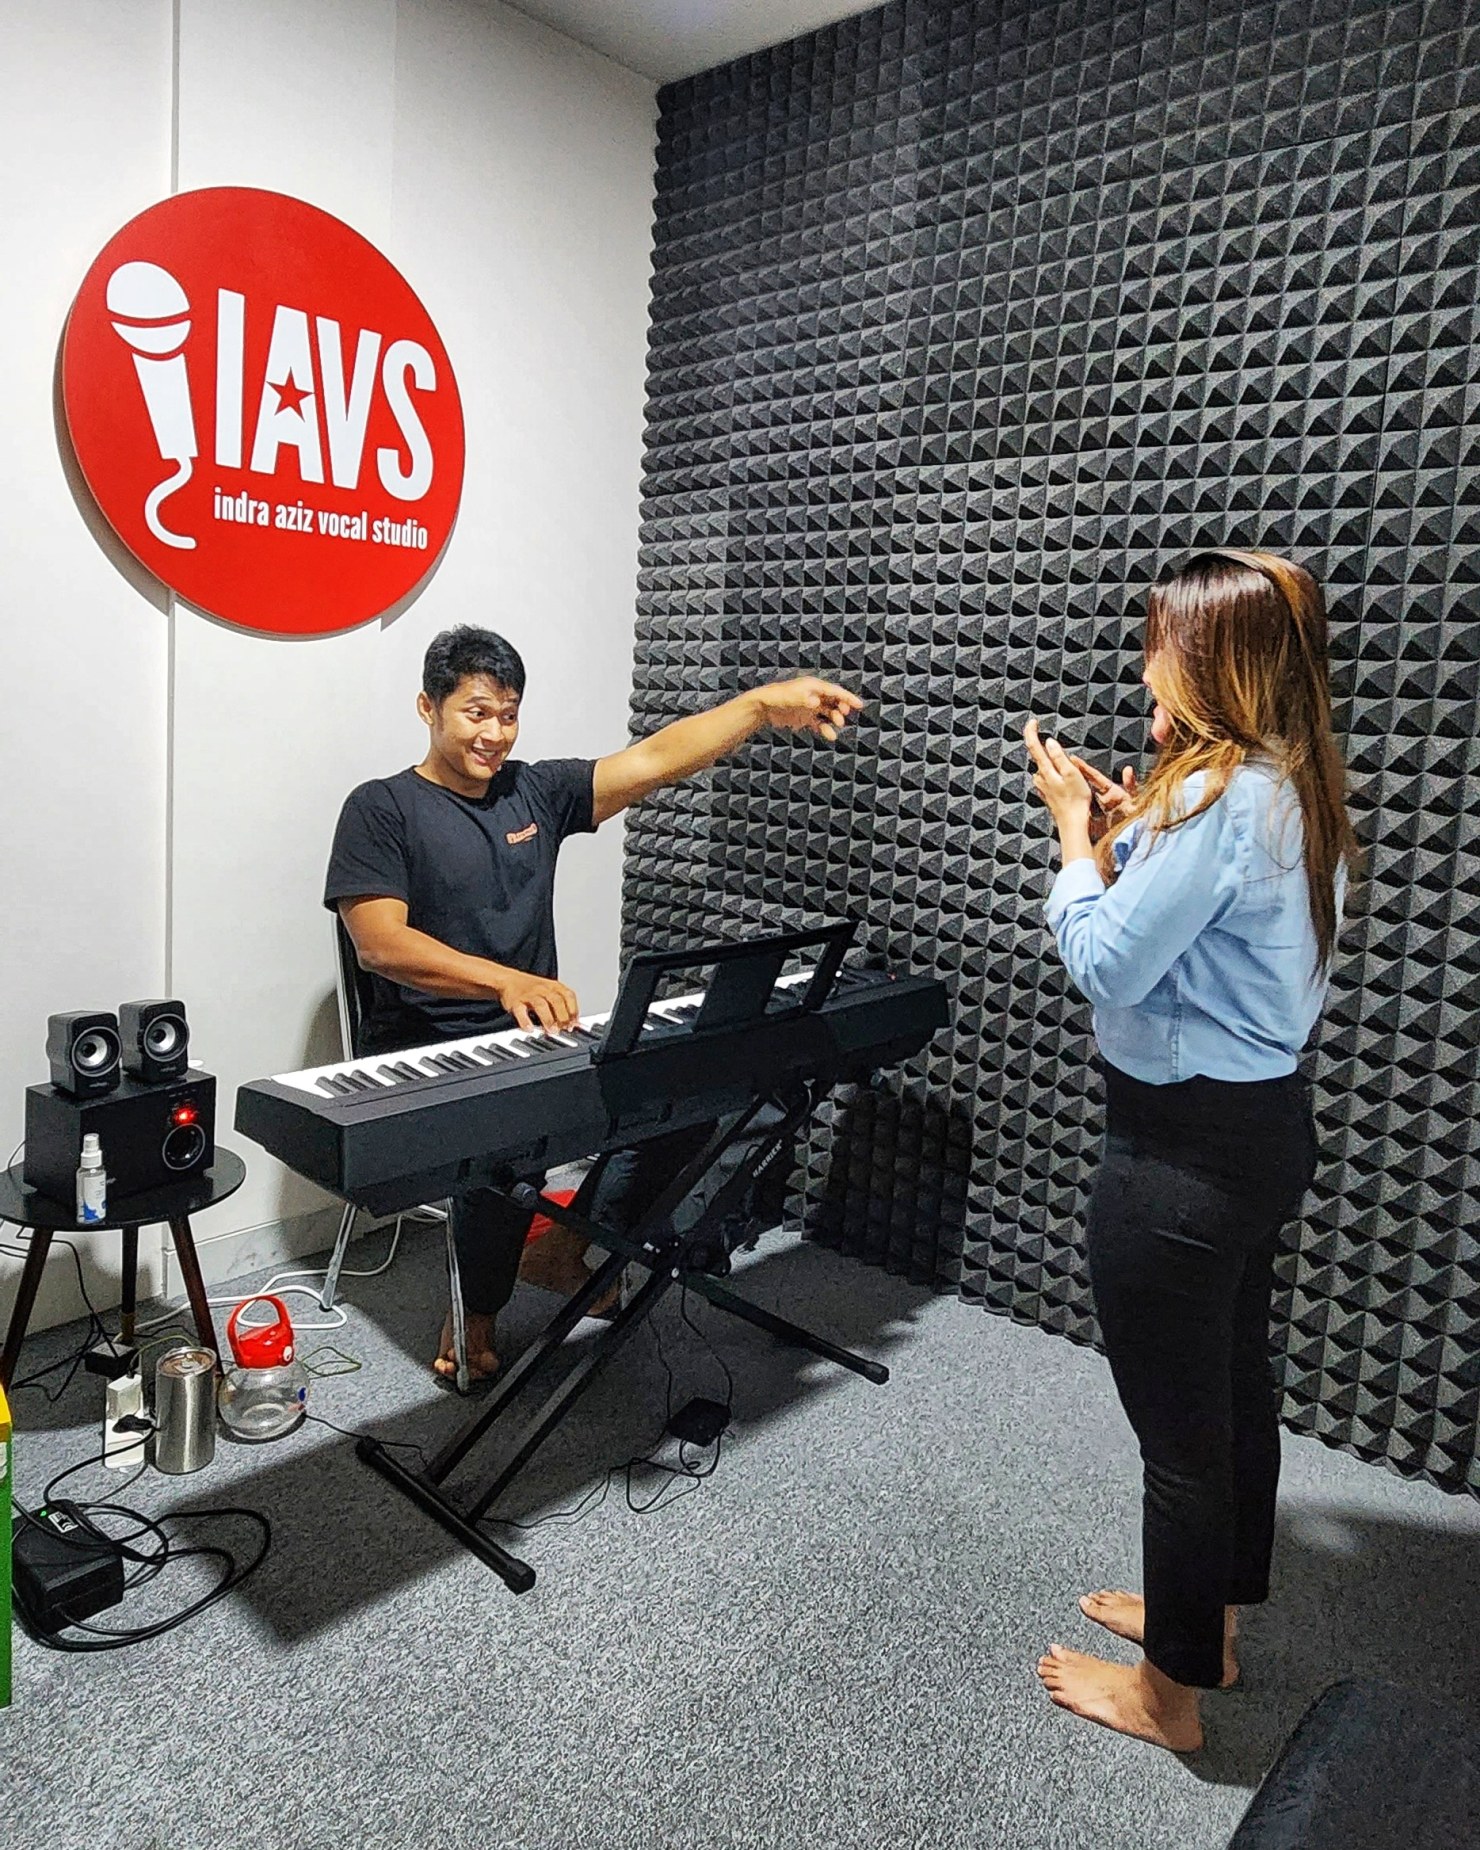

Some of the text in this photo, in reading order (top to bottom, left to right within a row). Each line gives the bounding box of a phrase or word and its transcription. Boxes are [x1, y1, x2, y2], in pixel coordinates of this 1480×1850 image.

[215, 288, 437, 501] IAVS
[214, 486, 428, 550] indra aziz vocal studio
